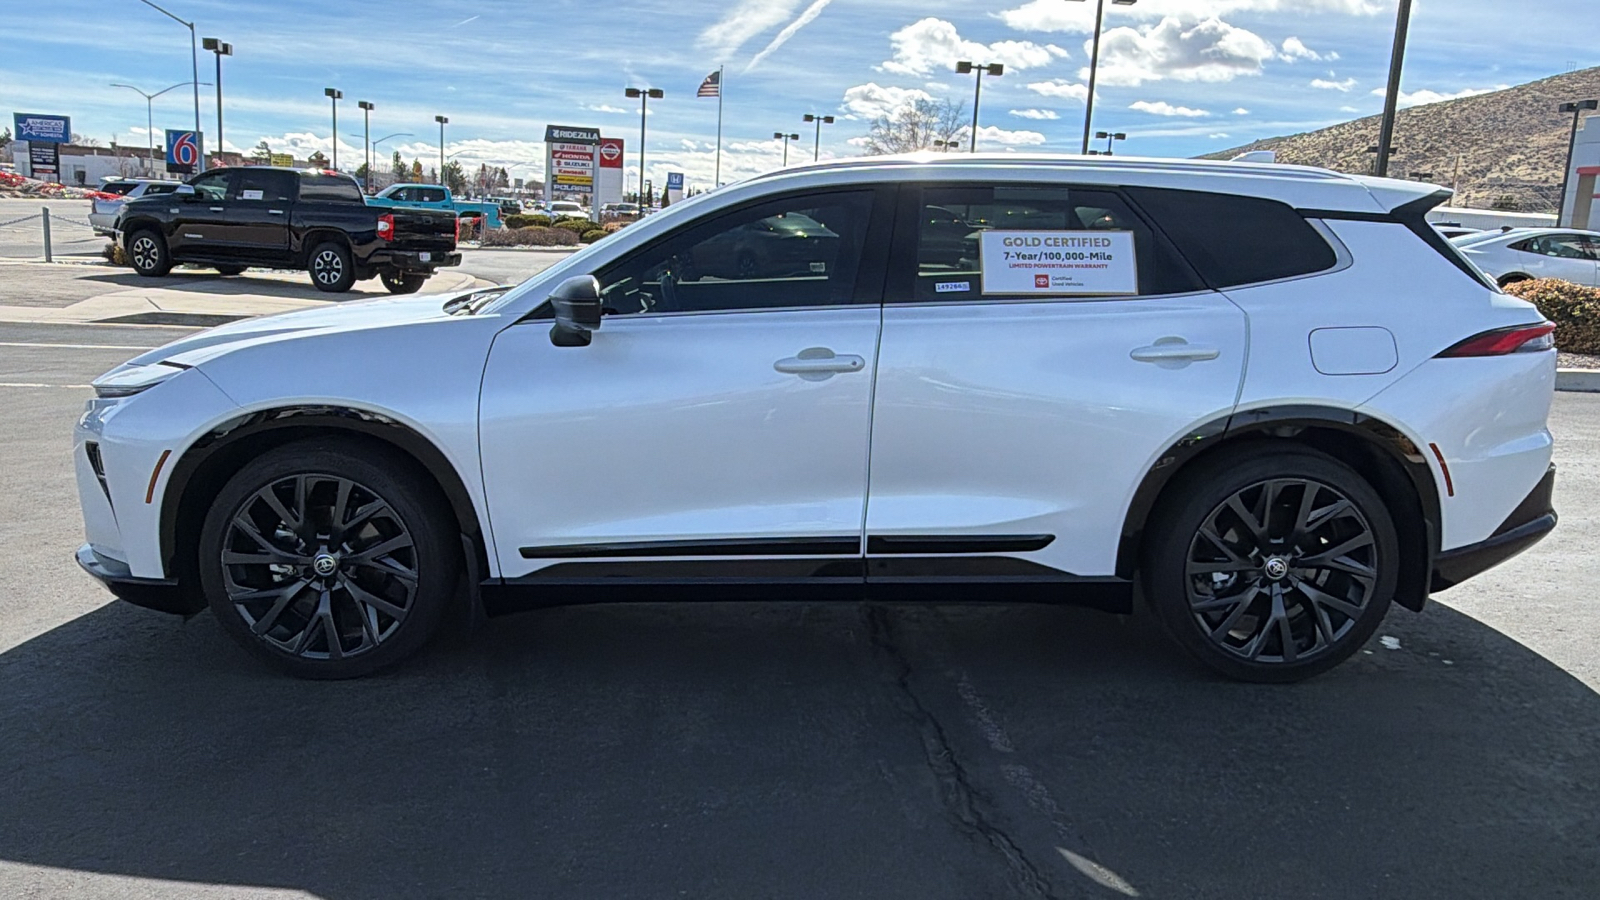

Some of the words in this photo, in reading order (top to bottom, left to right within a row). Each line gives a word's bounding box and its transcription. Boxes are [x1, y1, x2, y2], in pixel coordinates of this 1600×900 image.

[560, 130, 599, 140] RIDEZILLA
[173, 132, 198, 165] 6
[553, 184, 592, 192] POLARIS
[1003, 237, 1041, 247] GOLD
[1044, 237, 1111, 248] CERTIFIED
[1003, 252, 1113, 262] 7-Year/100,000-Mile
